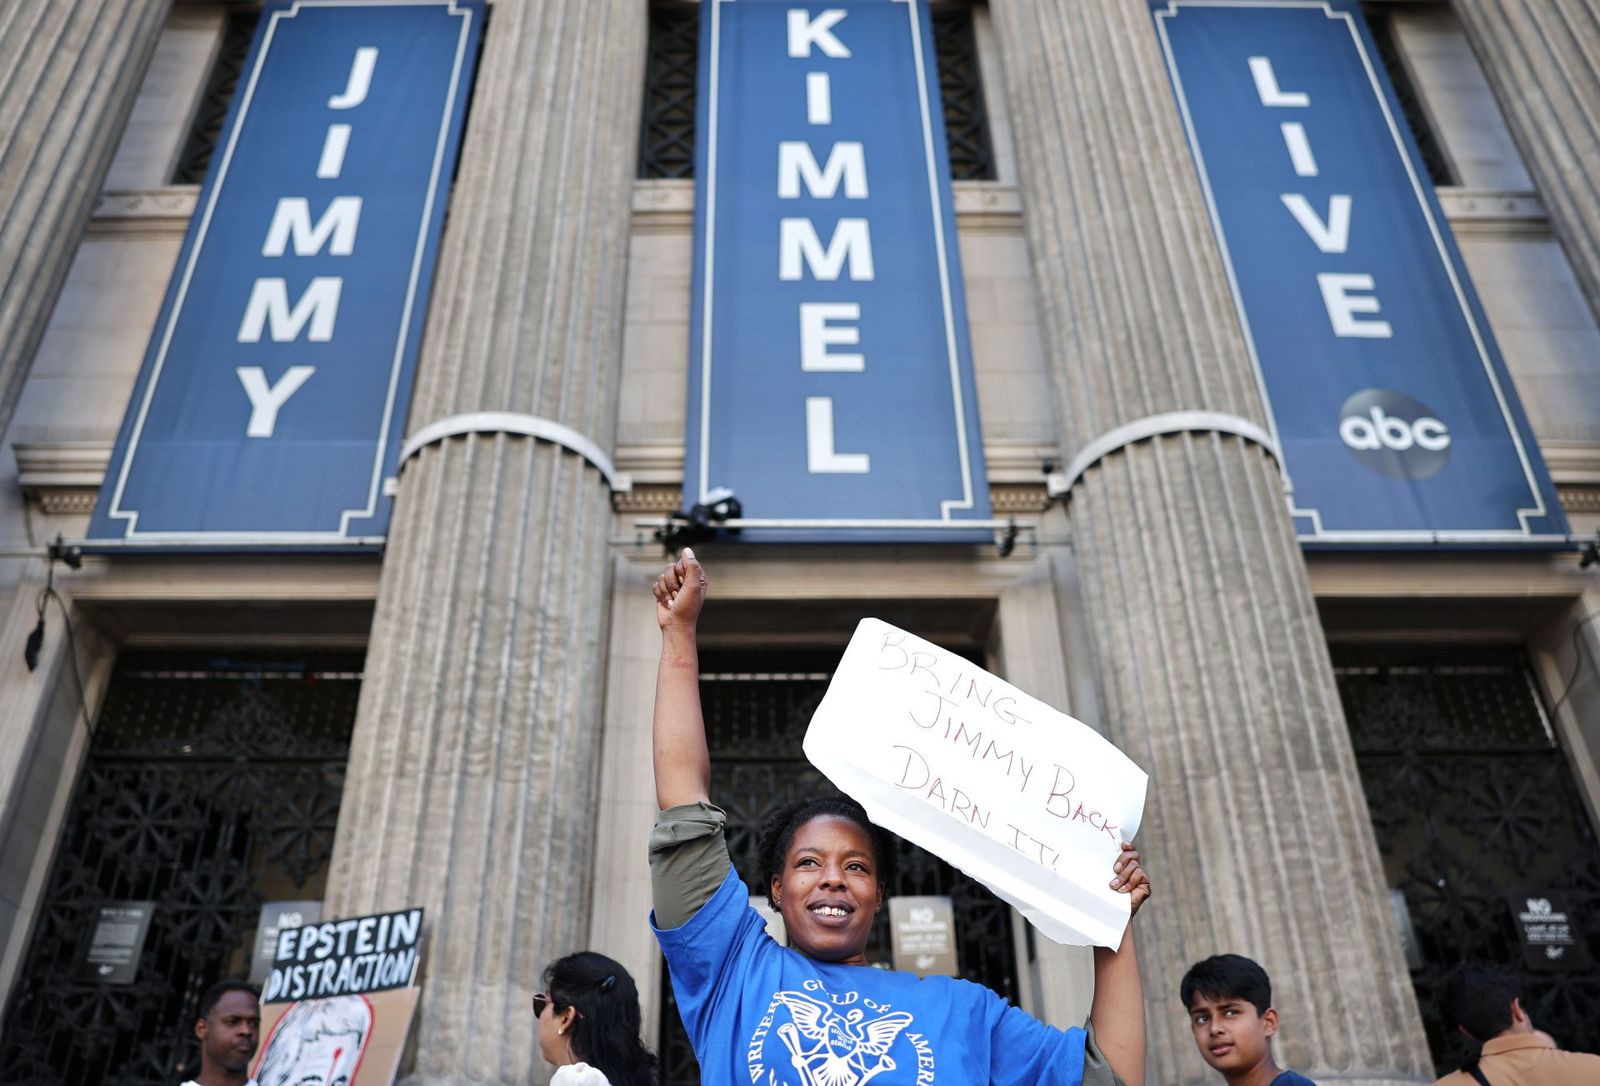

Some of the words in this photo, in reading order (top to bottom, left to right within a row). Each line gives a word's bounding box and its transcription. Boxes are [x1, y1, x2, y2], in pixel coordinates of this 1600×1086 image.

[237, 47, 379, 438] JIMMY
[778, 9, 875, 474] KIMMEL
[1247, 57, 1393, 339] LIVE
[1339, 406, 1450, 451] abc
[878, 631, 1032, 725] BRING
[909, 690, 1034, 793] JIMMY
[892, 745, 991, 829] DARN
[1007, 823, 1060, 871] IT!
[277, 910, 422, 961] EPSTEIN
[279, 911, 303, 928] NO
[265, 947, 416, 1001] DISTRACTION
[802, 979, 859, 1005] GLD
[863, 998, 892, 1014] OF
[904, 1032, 936, 1086] AMER
